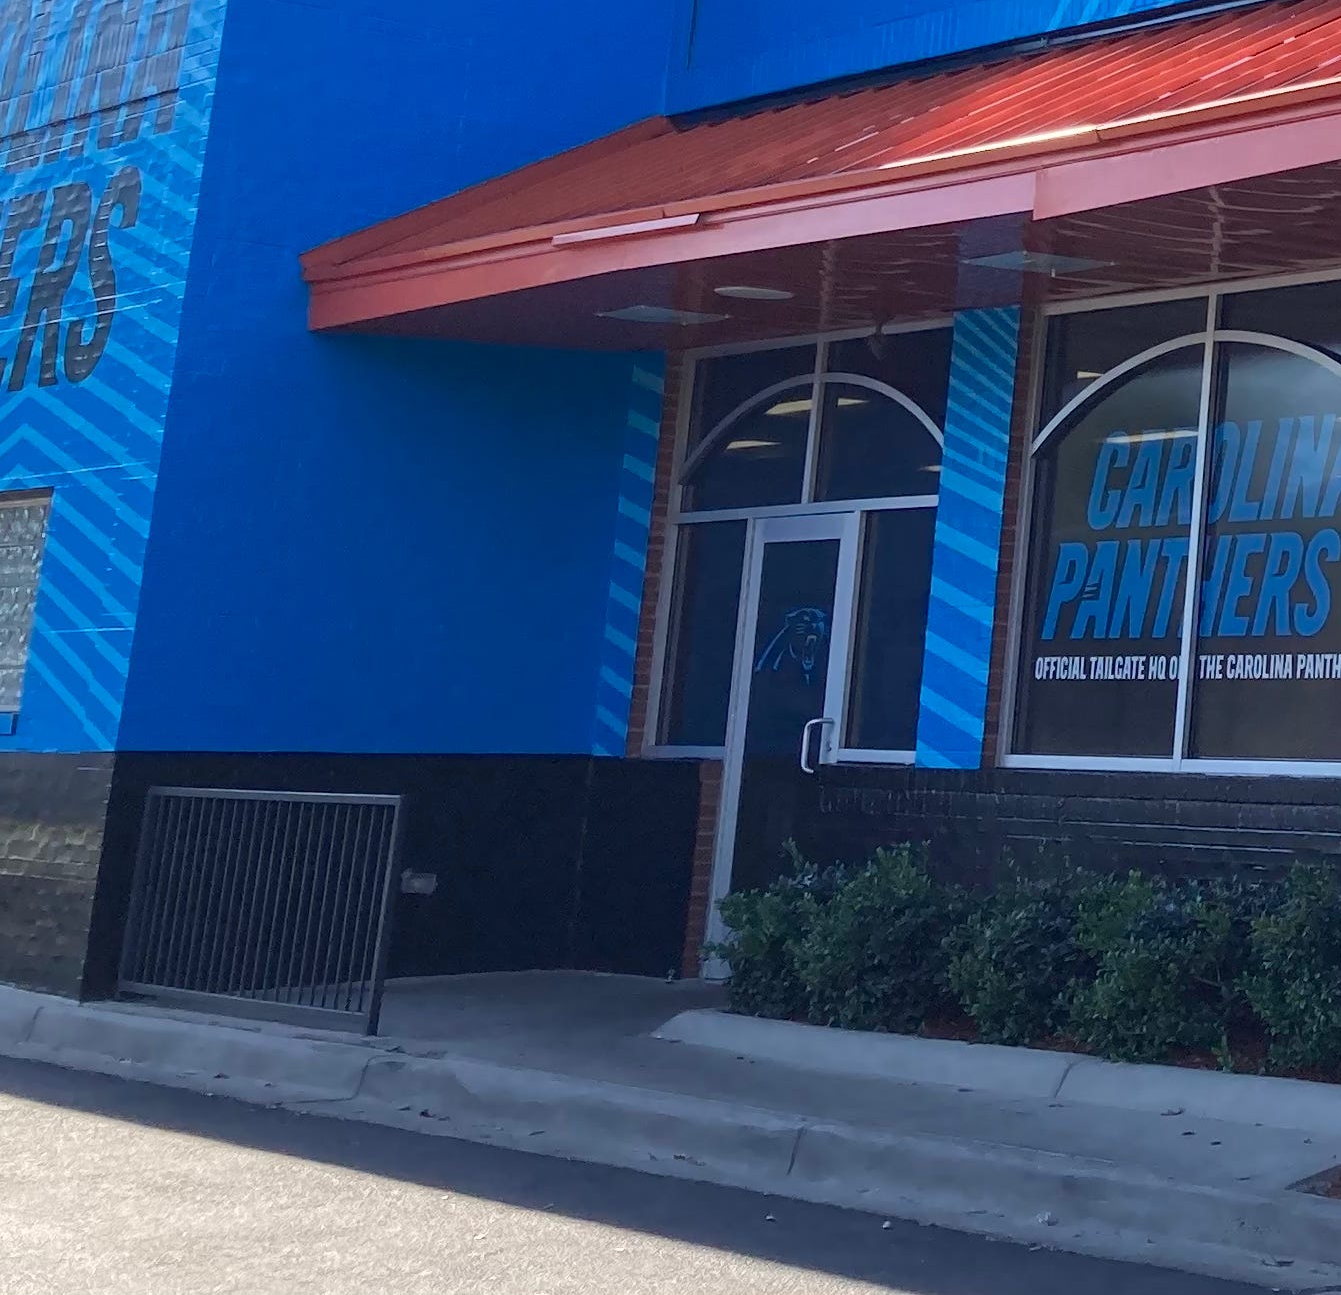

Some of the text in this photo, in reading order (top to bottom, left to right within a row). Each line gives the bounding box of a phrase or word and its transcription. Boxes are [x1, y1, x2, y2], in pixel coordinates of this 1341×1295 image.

[1035, 657, 1086, 680] OFFICIAL
[1089, 656, 1146, 679] TAILGATE
[1148, 656, 1168, 679] HQ
[1200, 655, 1224, 679] THE
[1226, 654, 1293, 679] CAROLINA
